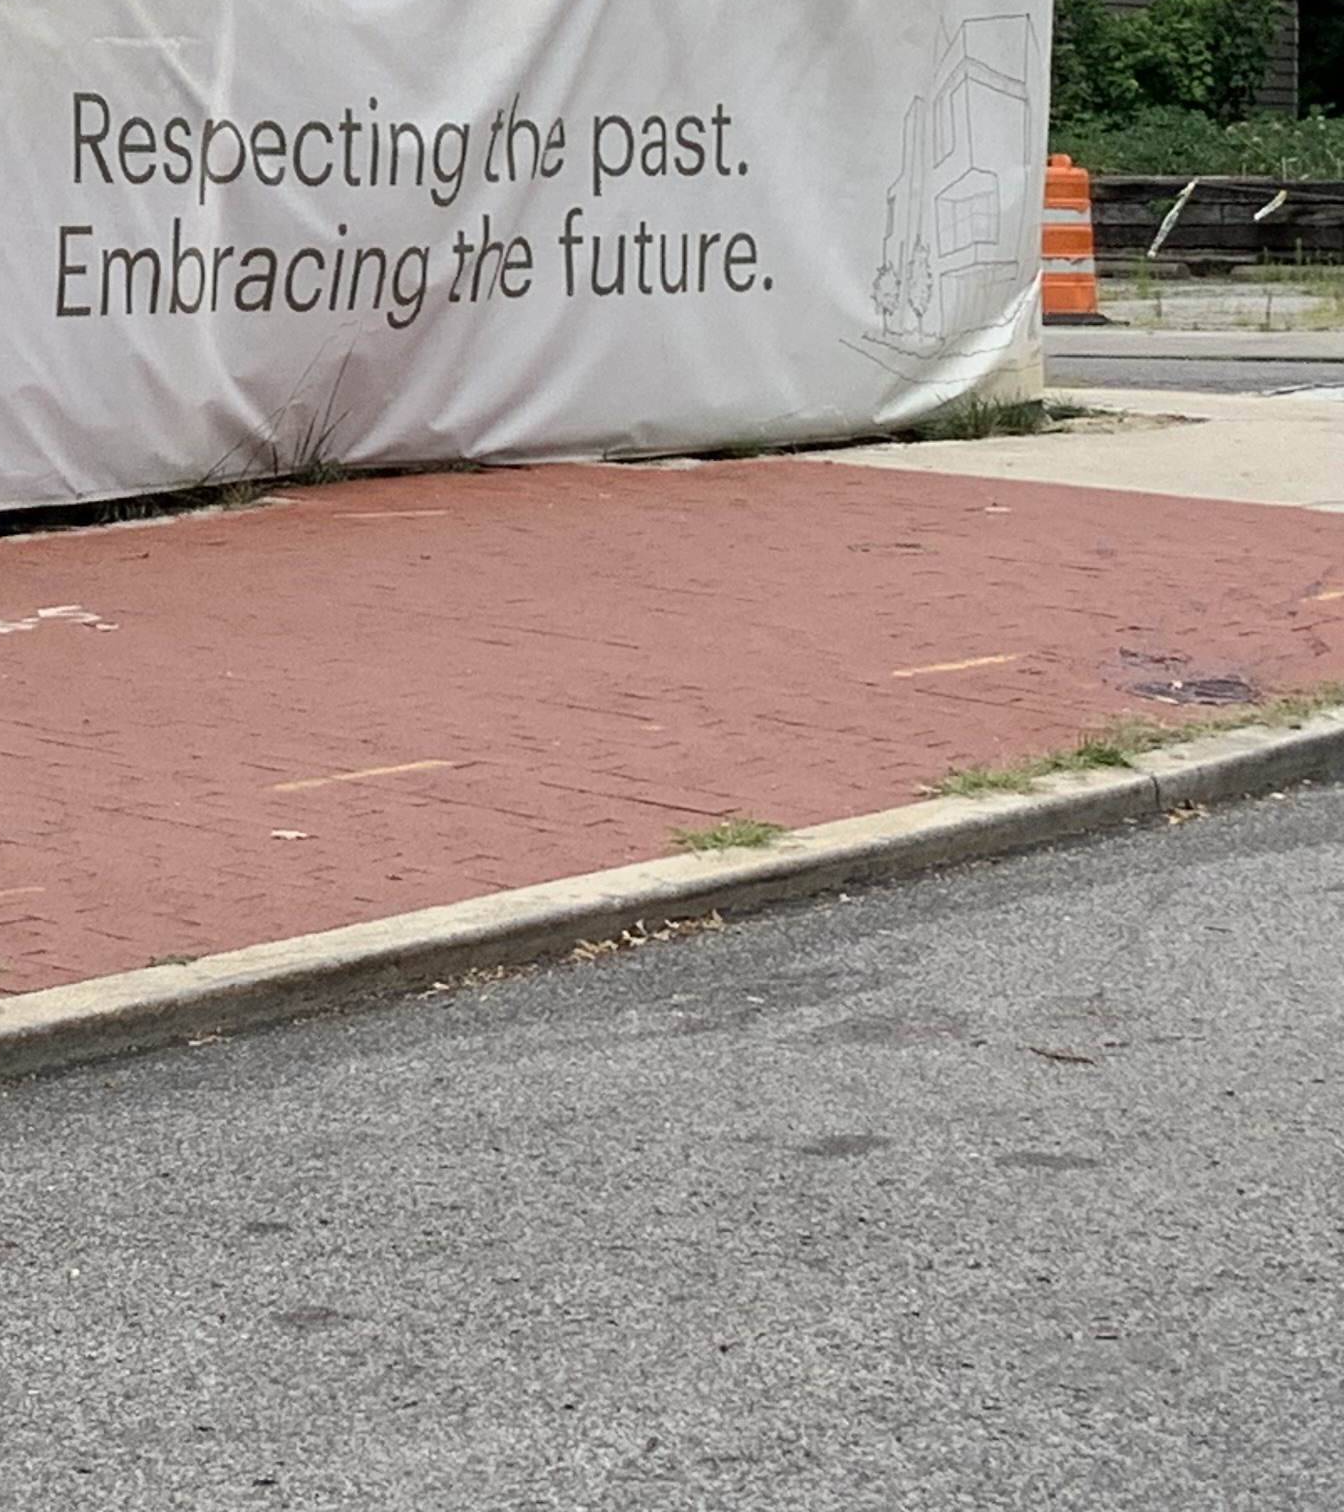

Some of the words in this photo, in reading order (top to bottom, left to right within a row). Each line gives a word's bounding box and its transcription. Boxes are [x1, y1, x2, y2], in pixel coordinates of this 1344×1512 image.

[72, 91, 471, 207] Respecting
[483, 92, 567, 184] the
[592, 102, 749, 197] past.
[55, 217, 431, 331] Embracing
[446, 213, 534, 304] the
[557, 206, 774, 298] future.
